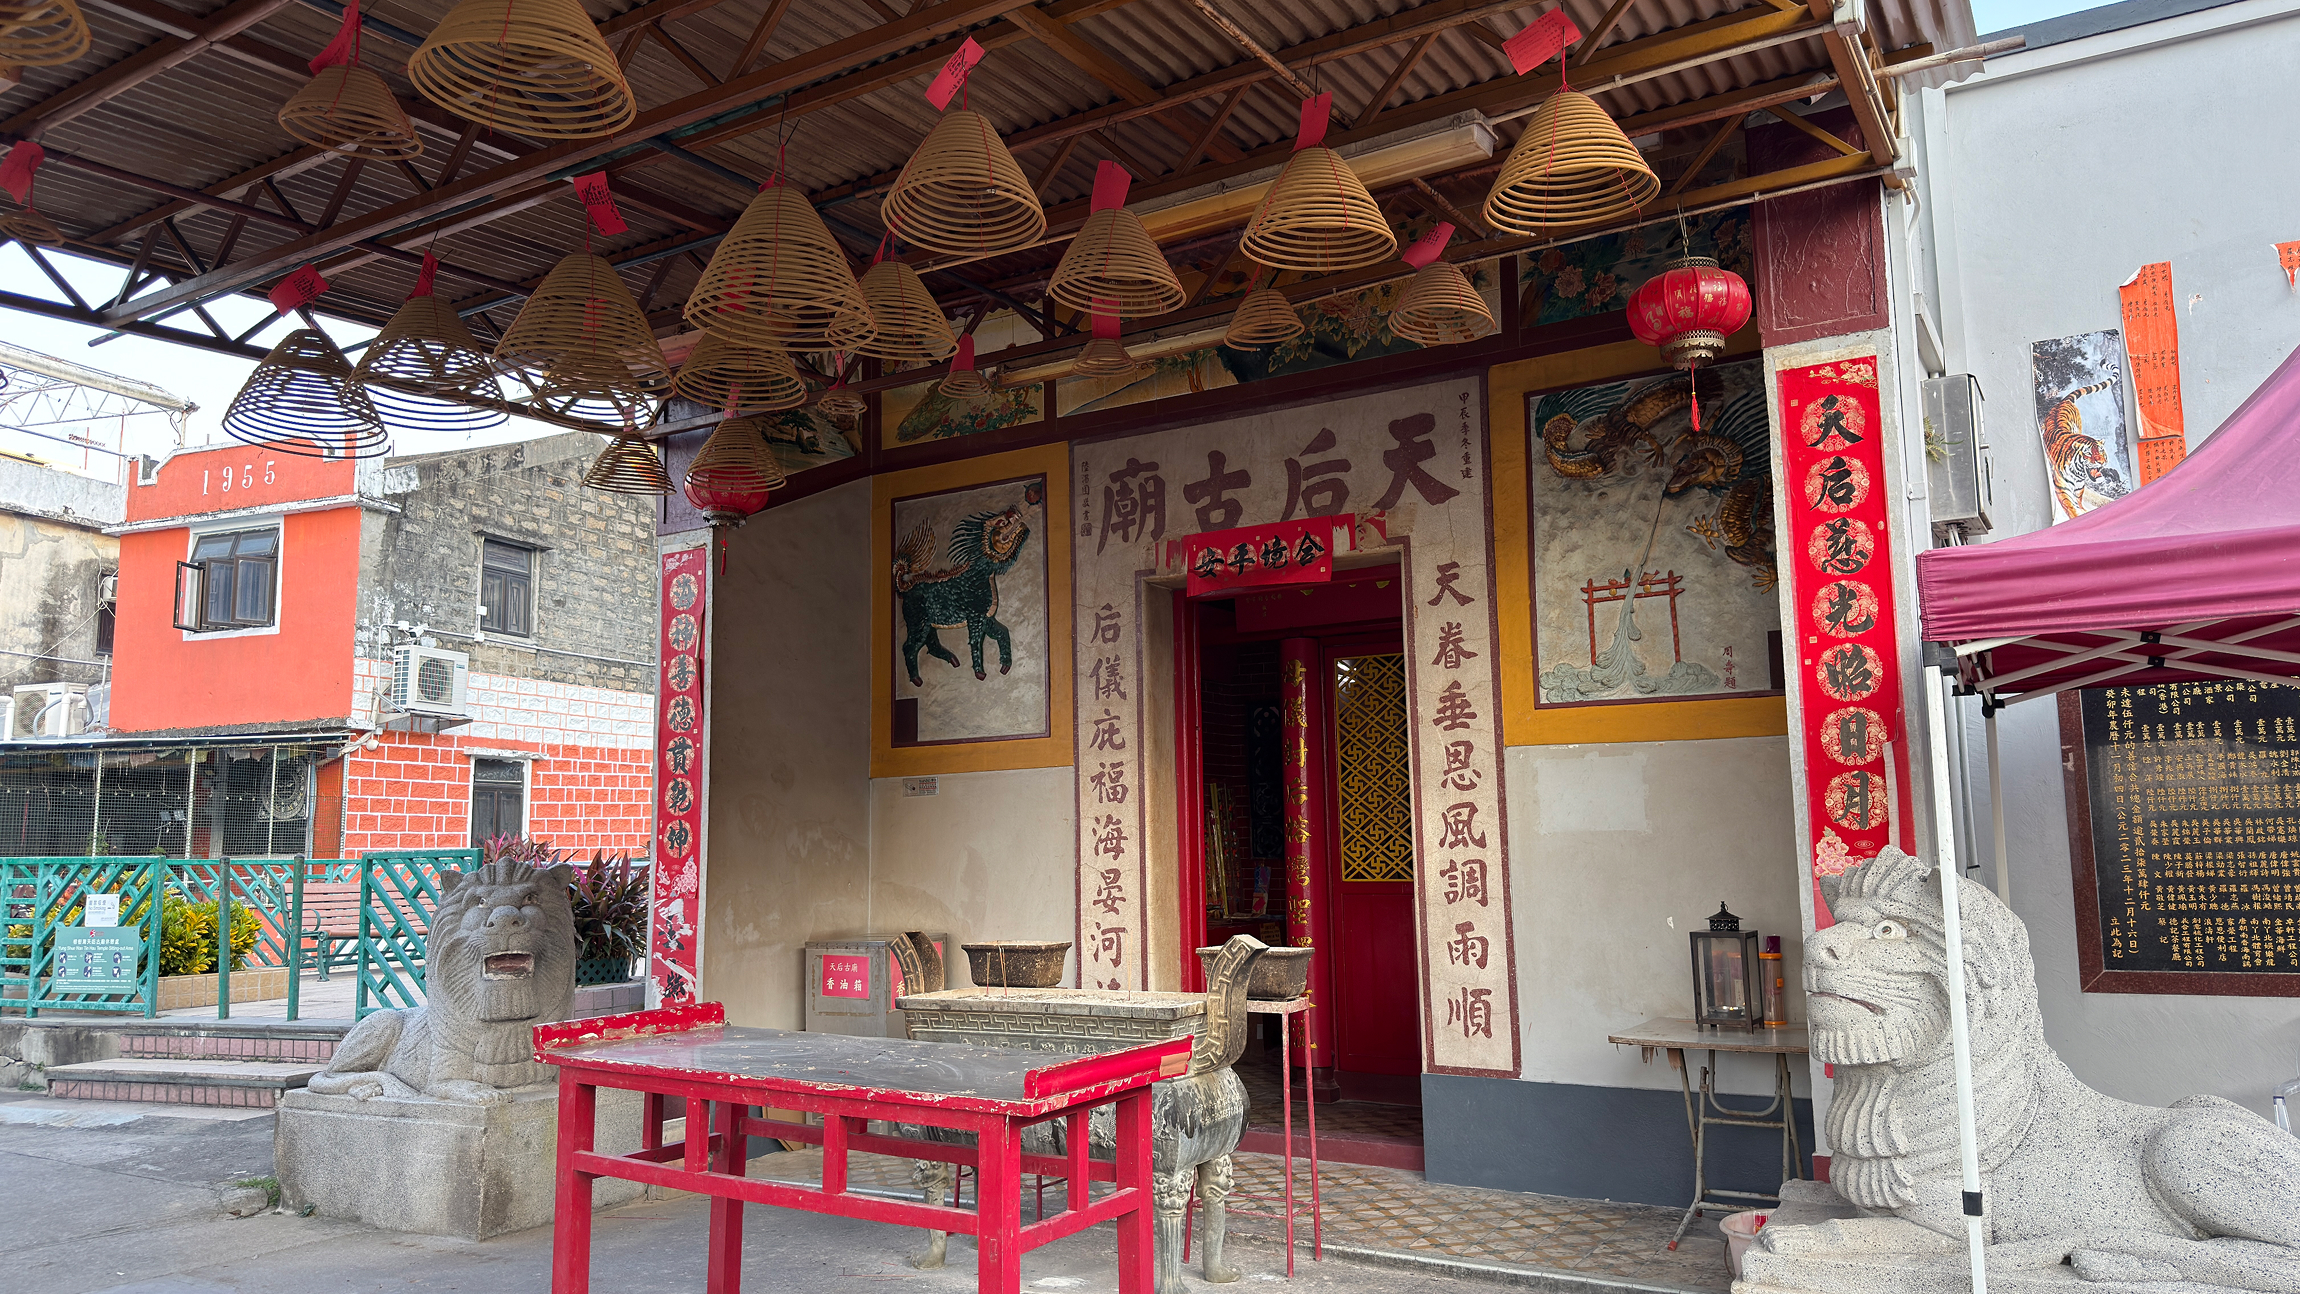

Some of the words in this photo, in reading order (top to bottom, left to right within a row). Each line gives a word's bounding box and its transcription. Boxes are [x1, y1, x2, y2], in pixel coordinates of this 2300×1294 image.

[1459, 392, 1473, 479] 甲辰季冬重建
[203, 461, 275, 495] 1955
[1097, 412, 1460, 557] 天后古廟
[1193, 530, 1325, 579] 合境平安
[666, 574, 696, 859] 海神善德貫乾坤
[2203, 682, 2215, 704] 酒家
[1427, 562, 1493, 1039] 天眷垂恩風調雨順
[826, 977, 862, 992] 香油箱
[829, 962, 858, 973] 天后古廟
